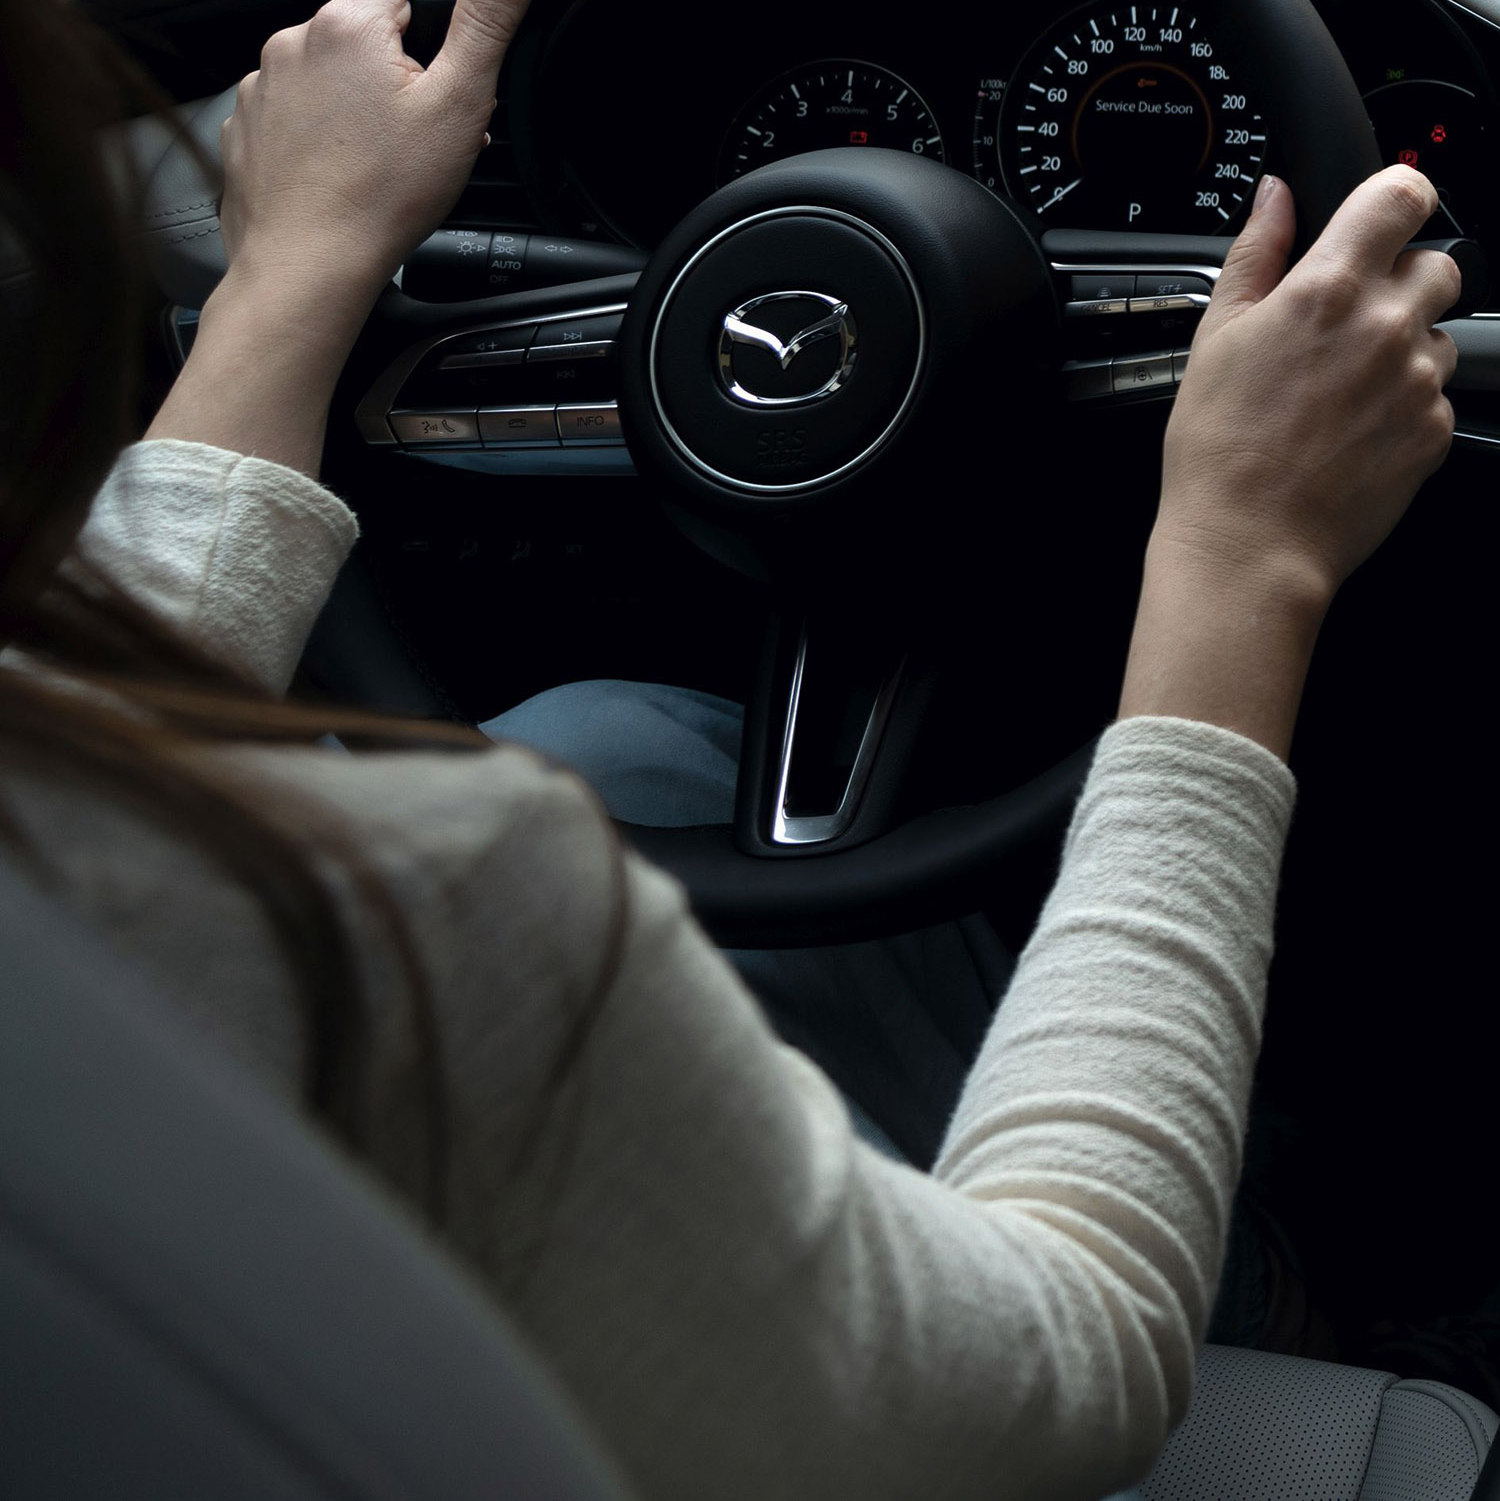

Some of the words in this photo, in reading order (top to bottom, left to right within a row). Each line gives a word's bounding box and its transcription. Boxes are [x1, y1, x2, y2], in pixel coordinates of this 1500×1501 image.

[1123, 27, 1146, 42] 120
[1159, 28, 1182, 43] 140
[1090, 39, 1114, 54] 100
[1139, 43, 1163, 53] km/h
[1190, 43, 1213, 58] 160
[1067, 60, 1088, 75] 80
[840, 88, 853, 104] 4
[988, 91, 1001, 101] 20
[1047, 87, 1068, 103] 60
[1221, 94, 1246, 110] 200
[795, 101, 808, 118] 3
[886, 104, 899, 121] 5
[1096, 98, 1136, 113] Service
[1138, 100, 1162, 114] Due
[1164, 101, 1193, 115] Soon
[1037, 120, 1059, 137] 40
[762, 131, 776, 147] 2
[983, 135, 994, 146] 10
[1224, 129, 1250, 145] 220
[912, 137, 925, 154] 6
[1041, 155, 1061, 171] 20
[1214, 163, 1240, 179] 240
[1195, 191, 1220, 208] 260
[1128, 202, 1142, 223] P
[491, 259, 522, 271] AUTO
[489, 274, 512, 285] OFF
[1153, 299, 1169, 309] RES
[576, 414, 605, 427] INFO
